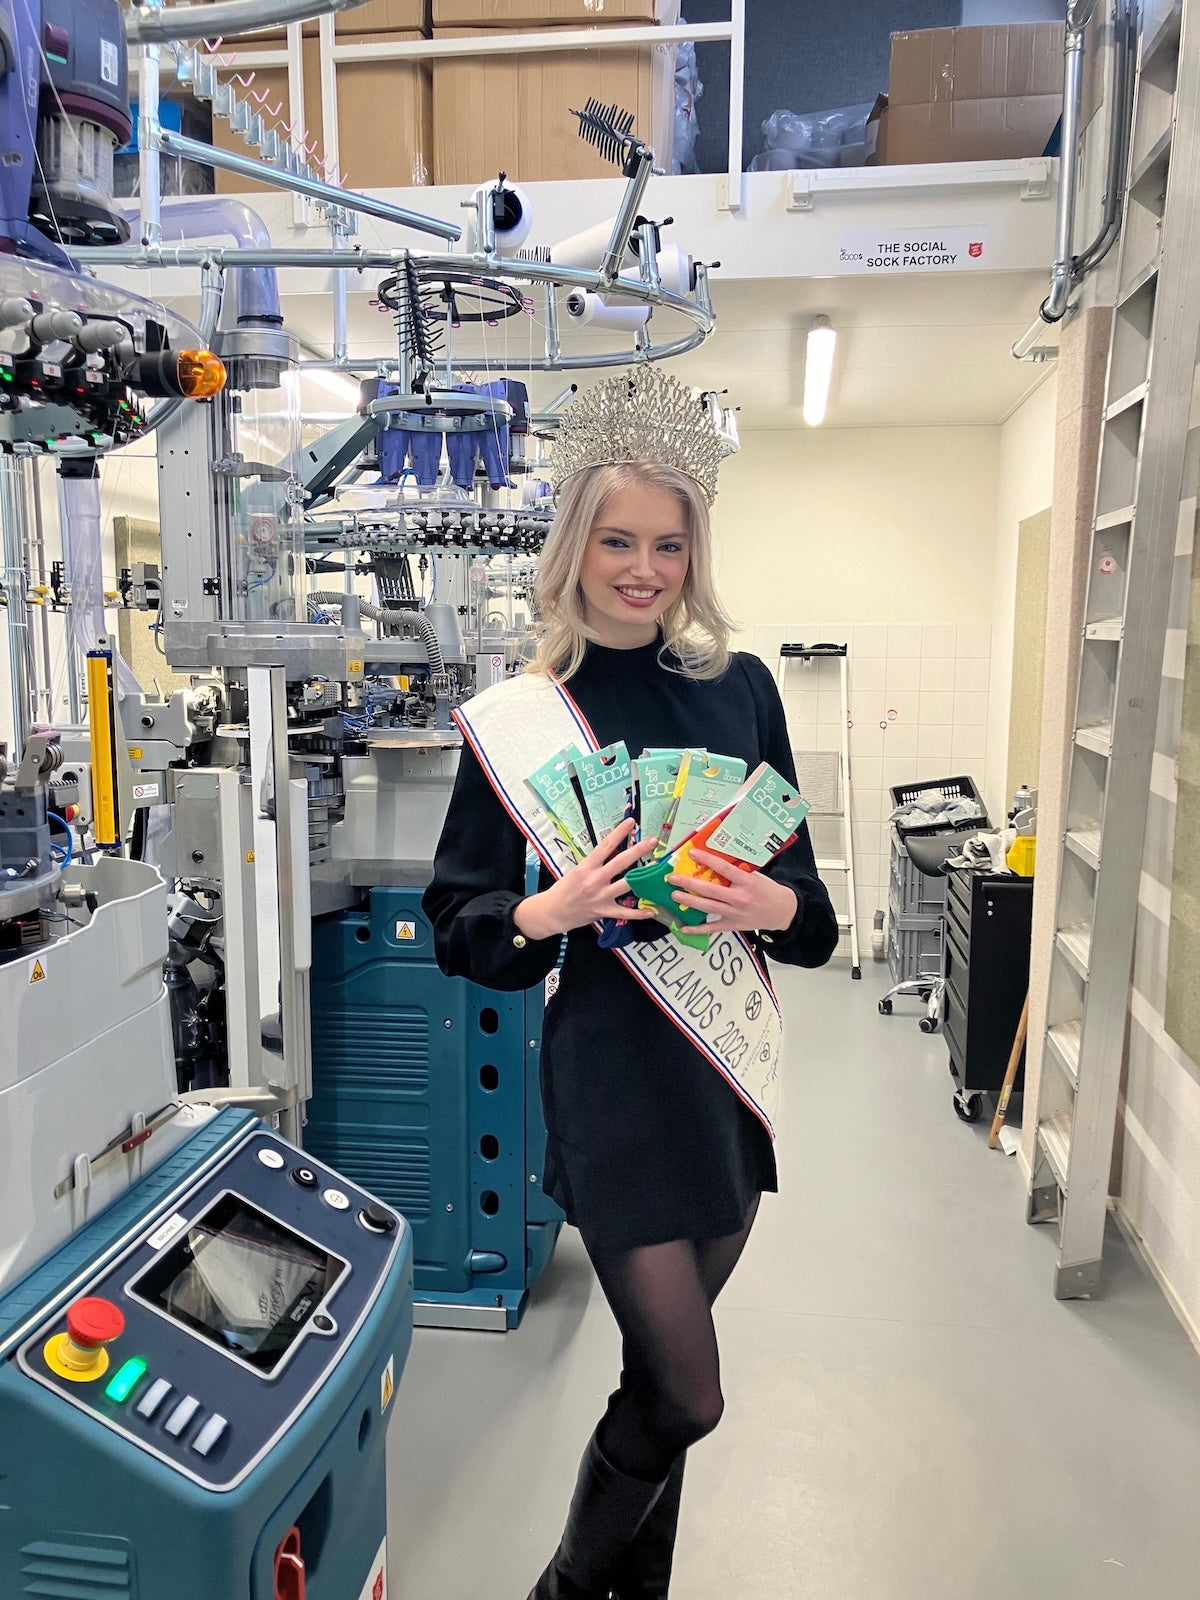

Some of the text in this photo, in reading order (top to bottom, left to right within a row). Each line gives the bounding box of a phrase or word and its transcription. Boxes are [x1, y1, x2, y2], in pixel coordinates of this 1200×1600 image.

[866, 254, 957, 268] SOCK FACTORY
[878, 242, 947, 254] THE SOCIAL
[585, 763, 630, 791] GOODS
[752, 787, 797, 828] GOODS
[701, 932, 743, 986] ISS
[633, 936, 749, 1070] ERLANDS 2023
